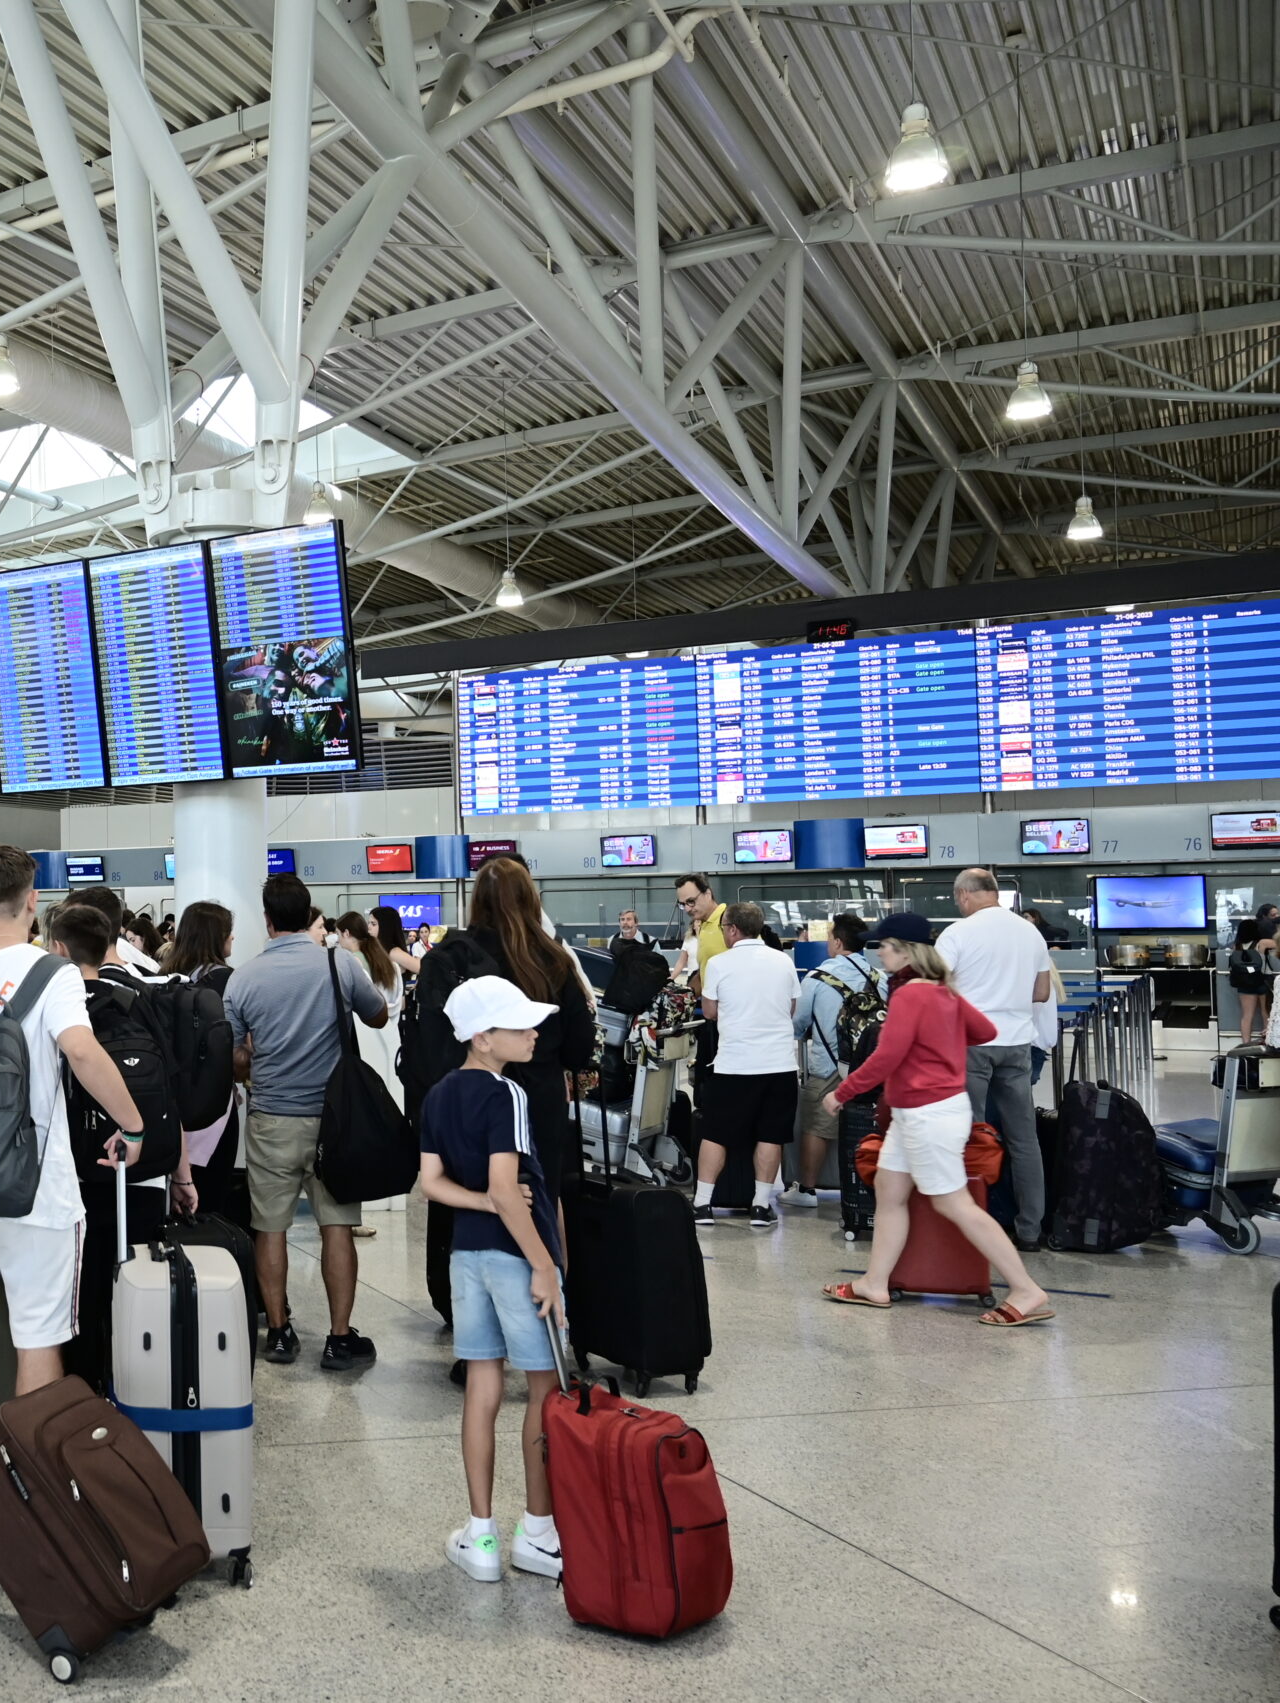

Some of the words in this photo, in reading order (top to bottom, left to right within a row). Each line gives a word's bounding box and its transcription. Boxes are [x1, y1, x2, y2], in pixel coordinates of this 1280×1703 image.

[1115, 611, 1153, 621] 21-06-2023
[976, 625, 1012, 633] Departures
[696, 652, 727, 660] Departures
[1102, 653, 1141, 662] Philadelphia
[283, 700, 300, 708] years
[308, 697, 322, 705] good
[285, 708, 297, 716] way
[306, 704, 331, 712] another.
[1102, 840, 1118, 853] 77
[1184, 838, 1201, 851] 76
[940, 846, 954, 858] 78
[584, 857, 595, 867] 80
[715, 853, 727, 865] 79
[304, 866, 314, 876] 83
[352, 865, 361, 875] 82
[112, 872, 120, 881] 85
[154, 871, 162, 880] 84
[399, 905, 423, 917] SAS
